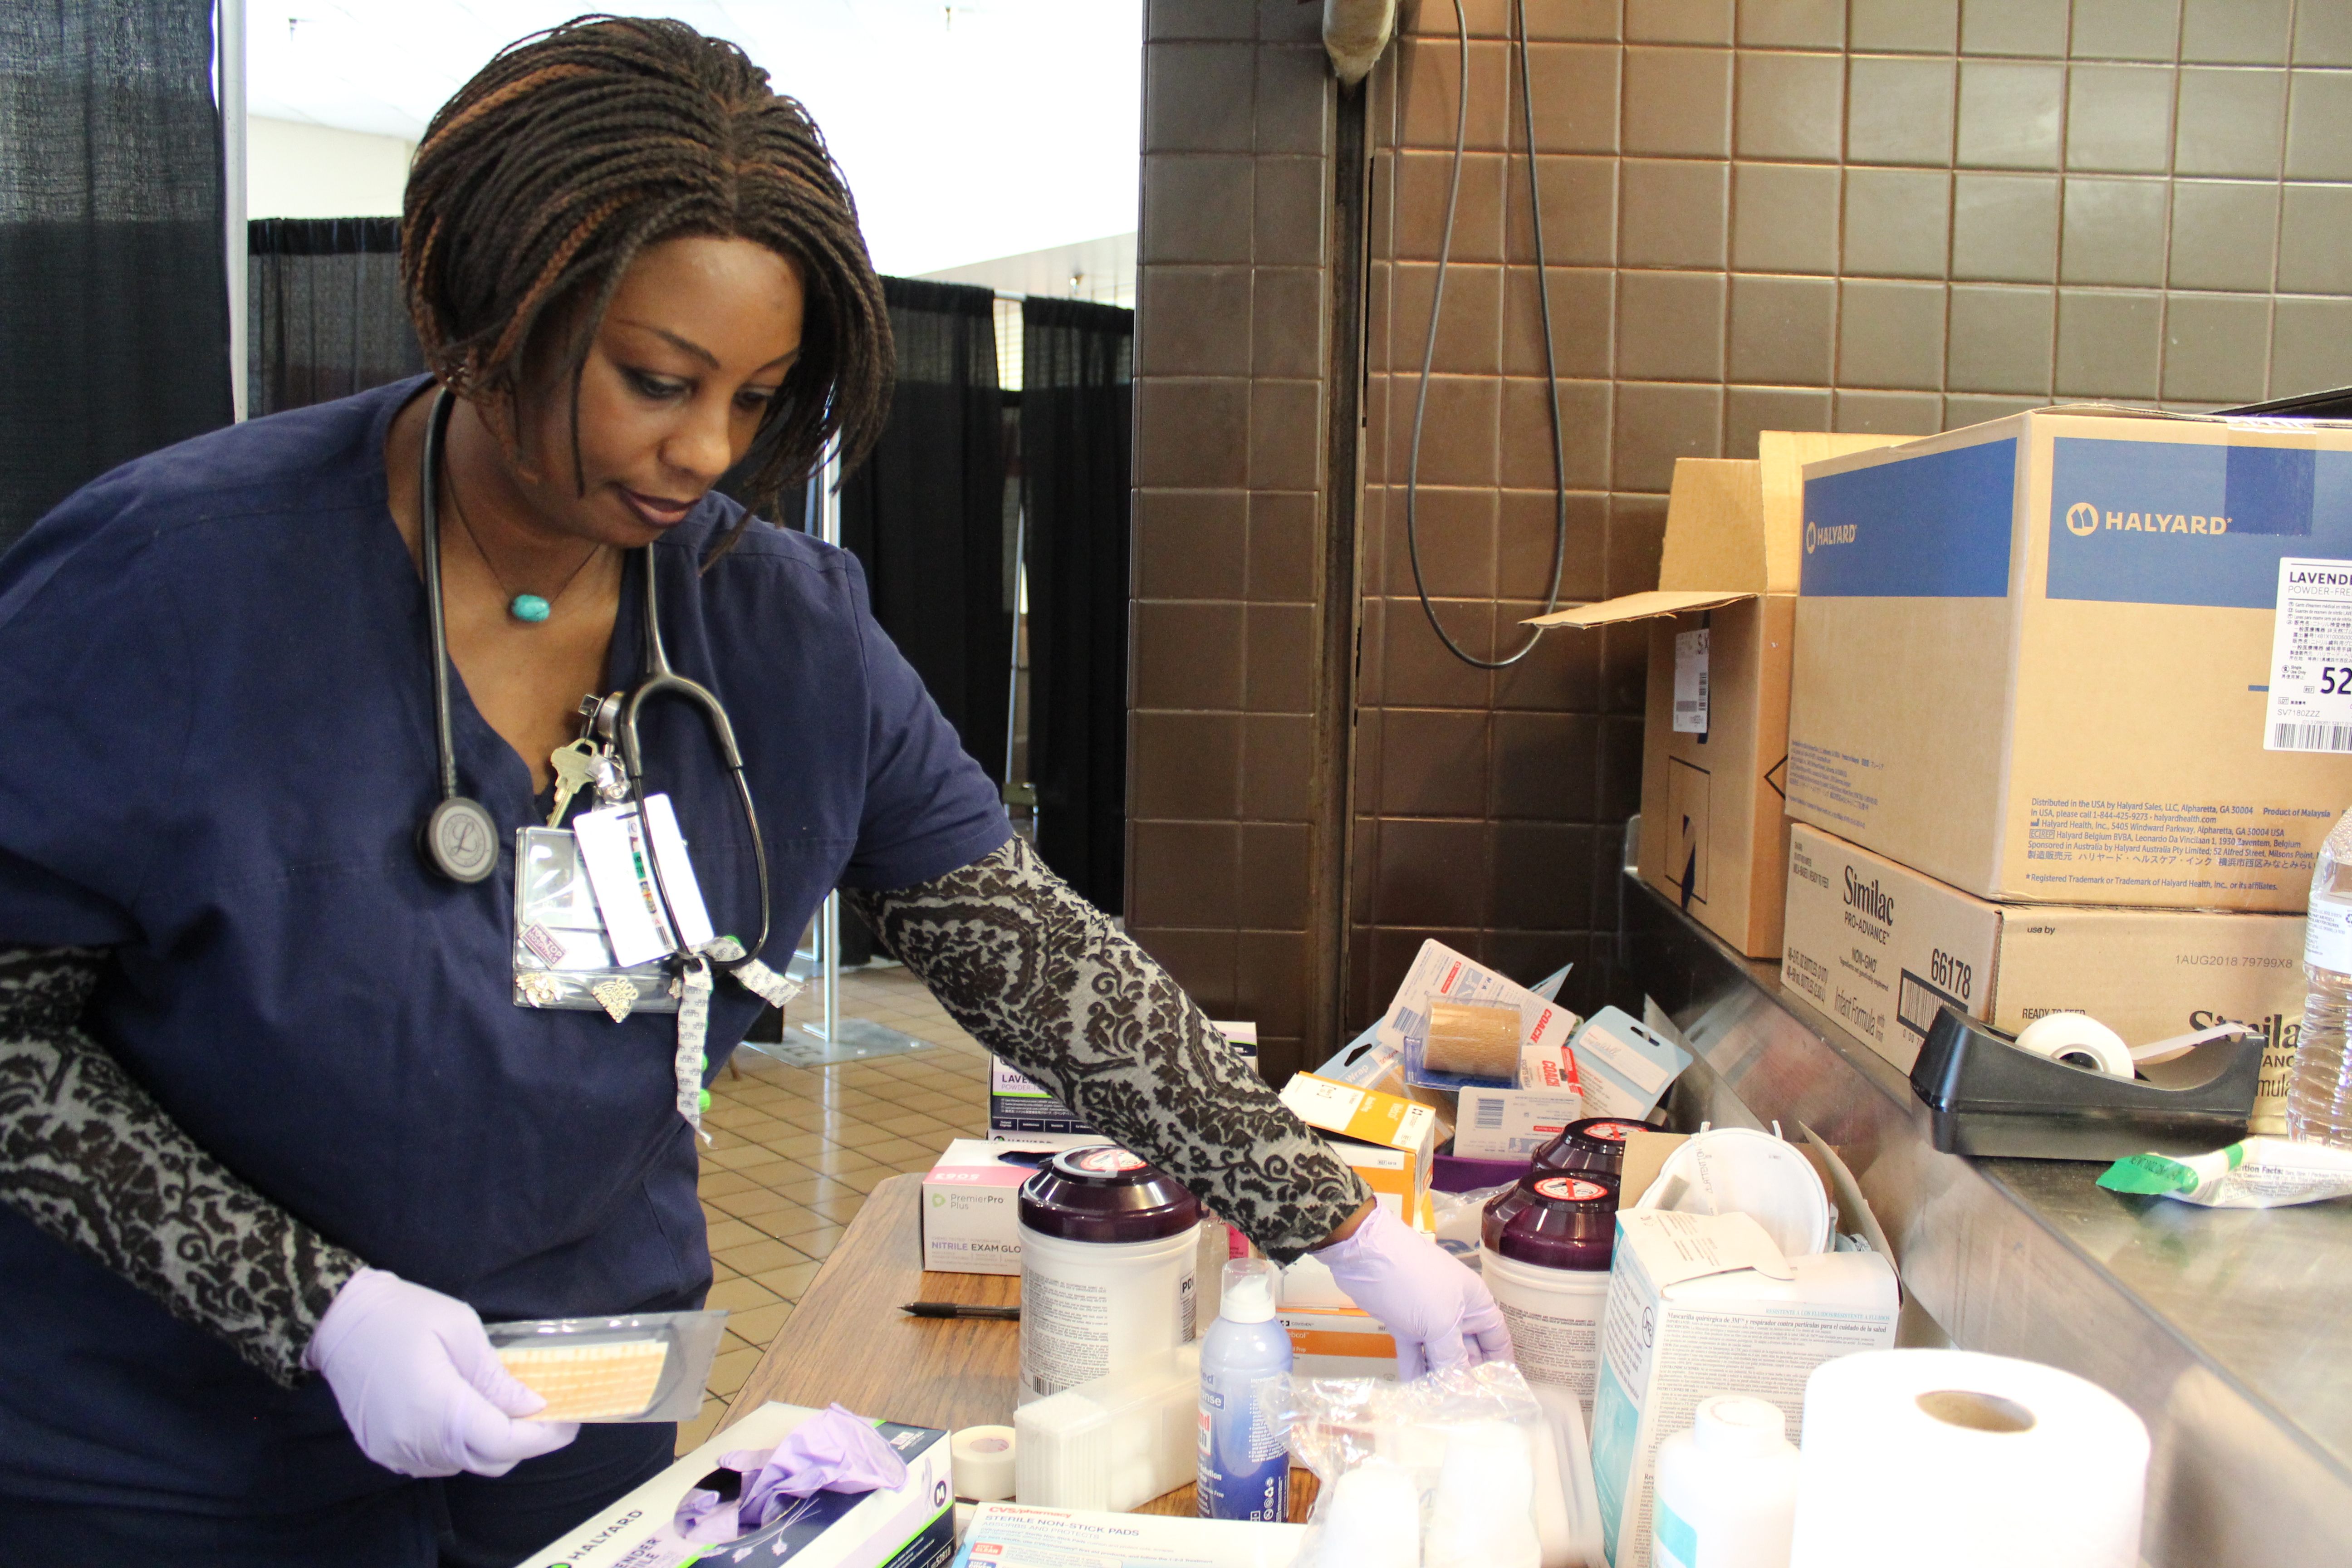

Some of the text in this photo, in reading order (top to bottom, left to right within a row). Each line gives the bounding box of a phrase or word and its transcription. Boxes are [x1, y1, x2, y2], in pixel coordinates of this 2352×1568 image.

[2289, 572, 2352, 585] LAVEND
[2288, 585, 2352, 596] POWDER-FRE
[2278, 709, 2320, 717] SV7180ZZZ
[2032, 798, 2069, 807] Distributed
[2117, 803, 2142, 811] Halyard
[2145, 803, 2163, 811] Sales,
[2181, 805, 2218, 814] Alpharetta,
[2263, 808, 2290, 816] Product
[2302, 809, 2331, 818] Malaysia
[2056, 810, 2078, 818] please
[2093, 811, 2148, 820] 1-844-425-9273
[2042, 820, 2068, 828] Halyard
[2070, 821, 2093, 829] Health,
[2131, 823, 2164, 832] Windward
[2166, 825, 2195, 834] Parkway,
[2198, 826, 2234, 836] Alpharetta,
[2057, 831, 2082, 840] Halyard
[2084, 832, 2112, 842] Belgium
[2114, 833, 2133, 842] BVBA,
[2136, 834, 2167, 843] Leonardo
[2180, 836, 2210, 845] Vincilaan
[2237, 838, 2271, 847] Zaventem,
[2274, 840, 2301, 849] Belgium
[2028, 841, 2064, 850] Sponsored
[2073, 843, 2103, 851] Australia
[2105, 844, 2112, 853] by
[2114, 844, 2140, 853] Halyard
[2142, 845, 2171, 853] Australia
[2185, 847, 2211, 855] Limited;
[2224, 848, 2244, 857] Alfred
[2245, 849, 2266, 858] Street,
[2269, 849, 2293, 858] Milsons
[2295, 850, 2314, 859] Point,
[2028, 851, 2072, 861] 製造販売元
[2069, 875, 2104, 884] Trademark
[2115, 877, 2151, 885] Trademark
[2161, 879, 2187, 888] Halyard
[2189, 880, 2212, 888] Health,
[2248, 882, 2278, 891] affiliates.
[1843, 865, 1894, 926] Similac
[2044, 926, 2055, 935] by
[527, 931, 558, 963] HOSPITALS
[547, 940, 562, 957] TOP
[2175, 955, 2293, 969] 1AUG2018 79799X8
[1931, 948, 1971, 1000] 66178
[616, 978, 638, 1000] GOD
[1835, 986, 1875, 1036] Infant Formula
[2022, 1008, 2049, 1019] READY
[1530, 1009, 1552, 1044] COACH
[2190, 1011, 2301, 1049] Sila
[1002, 1074, 1028, 1083] LAVE
[1345, 1065, 1369, 1083] Wrap
[1542, 1060, 1560, 1087] COACH
[2262, 1166, 2283, 1175] Facts:
[951, 1194, 1004, 1204] PremierPro
[931, 1241, 968, 1250] NITRILE
[971, 1244, 998, 1252] EXAM
[1668, 1312, 1695, 1321] Mascarilla
[1200, 1462, 1222, 1481] Solution
[936, 1485, 945, 1504] M
[989, 1506, 1072, 1518] CVS/pharmacy
[982, 1522, 1027, 1530] ABSORBS
[1054, 1528, 1100, 1539] PROTECTS
[985, 1515, 1140, 1536] STERILE NON-STICK PADS
[567, 1510, 643, 1560] HALYARD
[615, 1538, 662, 1568] ENDER
